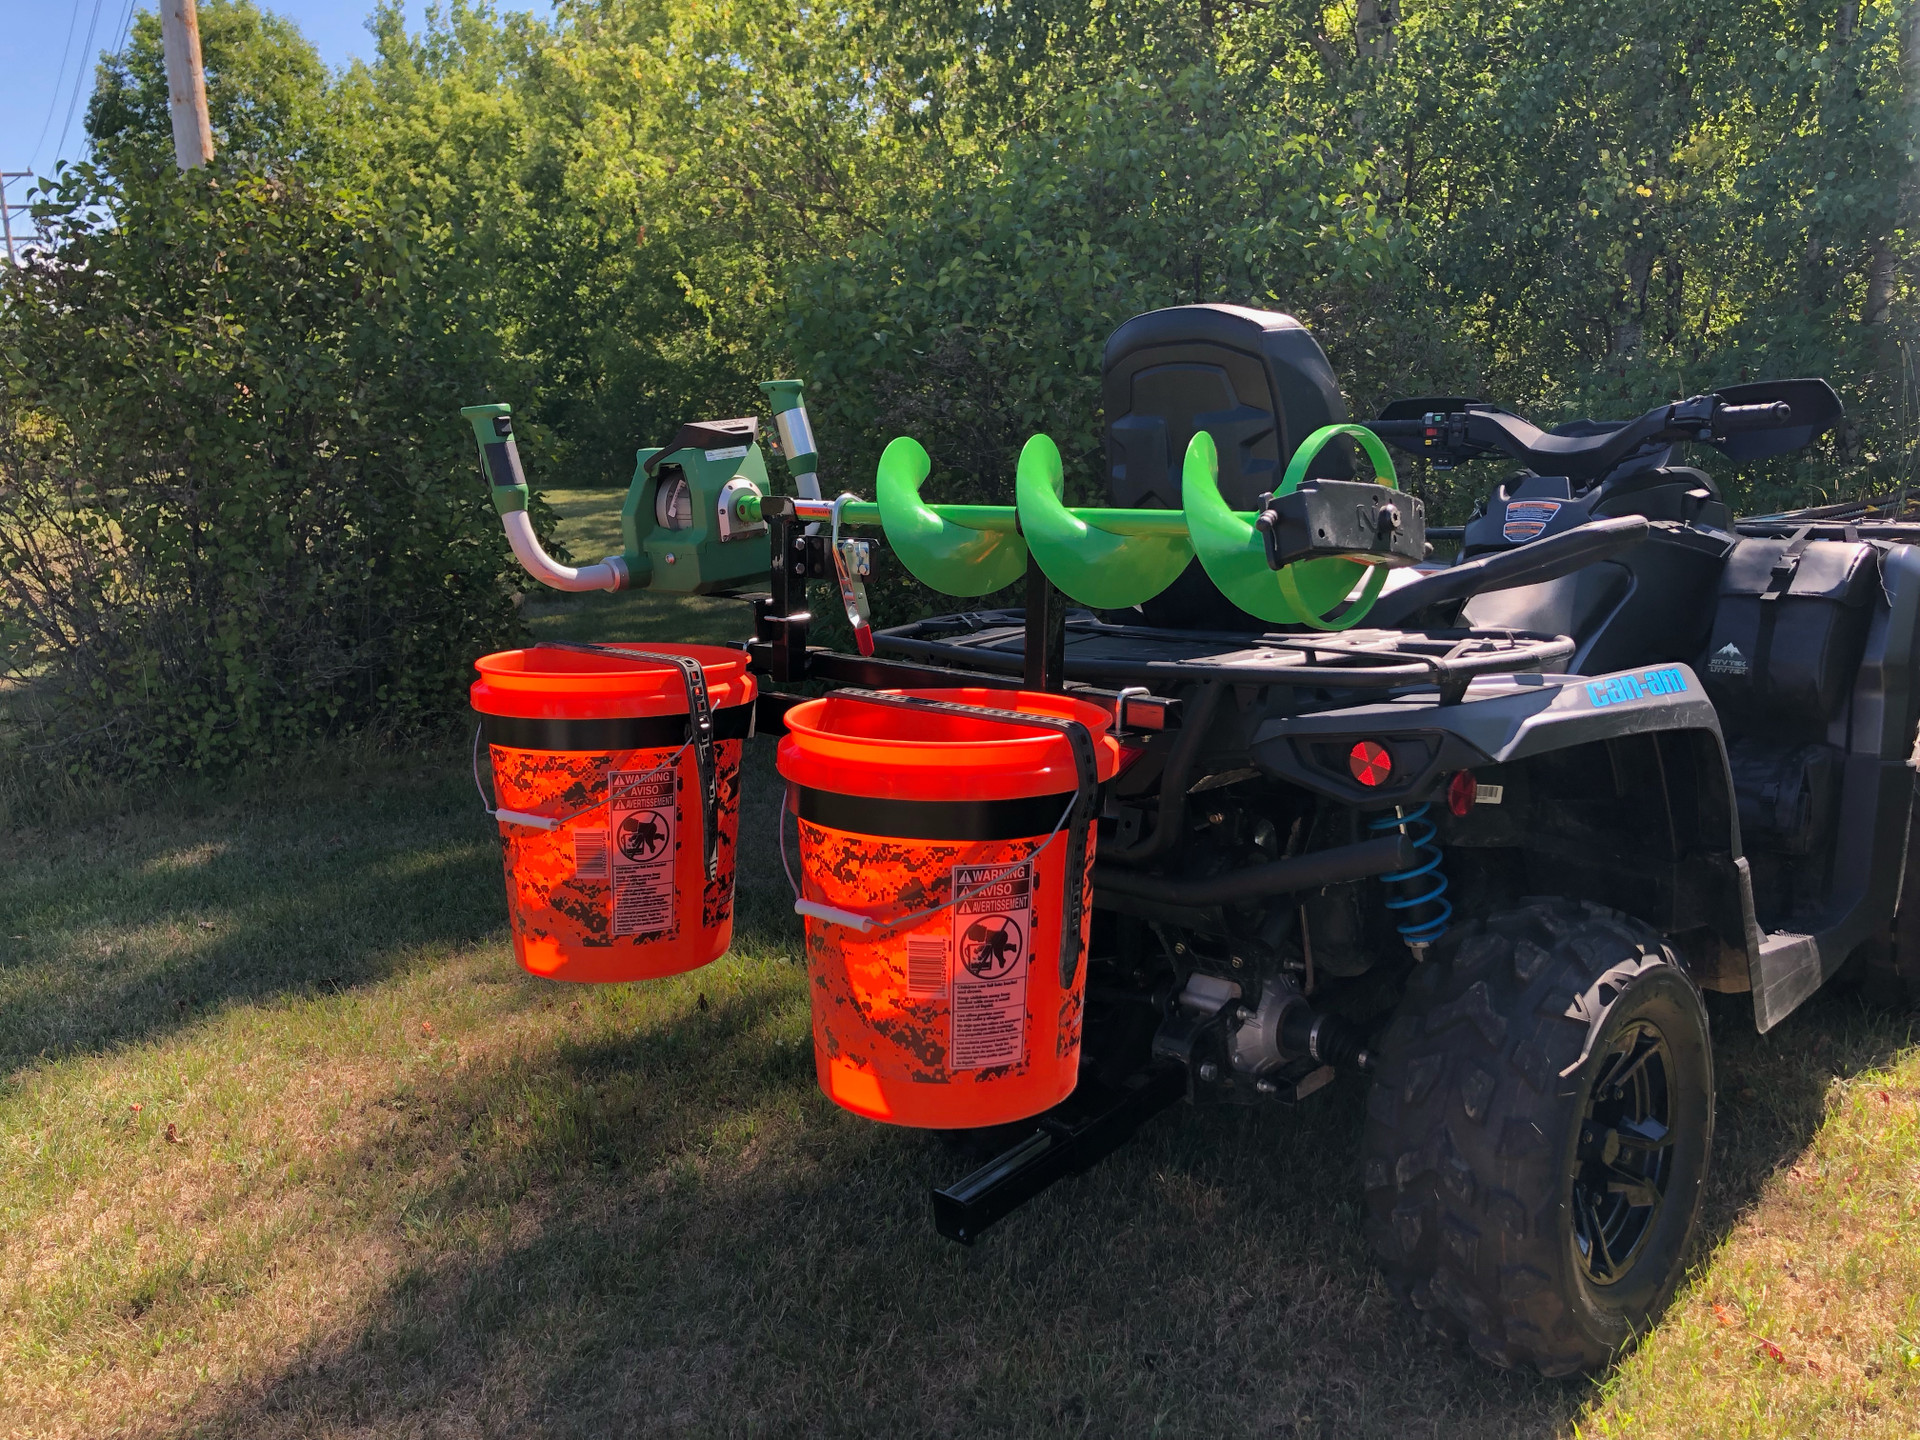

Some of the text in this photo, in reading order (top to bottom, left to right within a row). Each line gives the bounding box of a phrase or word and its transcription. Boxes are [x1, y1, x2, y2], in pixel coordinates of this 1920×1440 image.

[625, 771, 670, 784] WARNING
[631, 785, 659, 796] AVISO
[626, 796, 673, 809] AVERTISSEMENT
[972, 866, 1025, 882] WARNING
[979, 883, 1012, 897] AVISO
[972, 896, 1028, 913] AVERTISSEMENT
